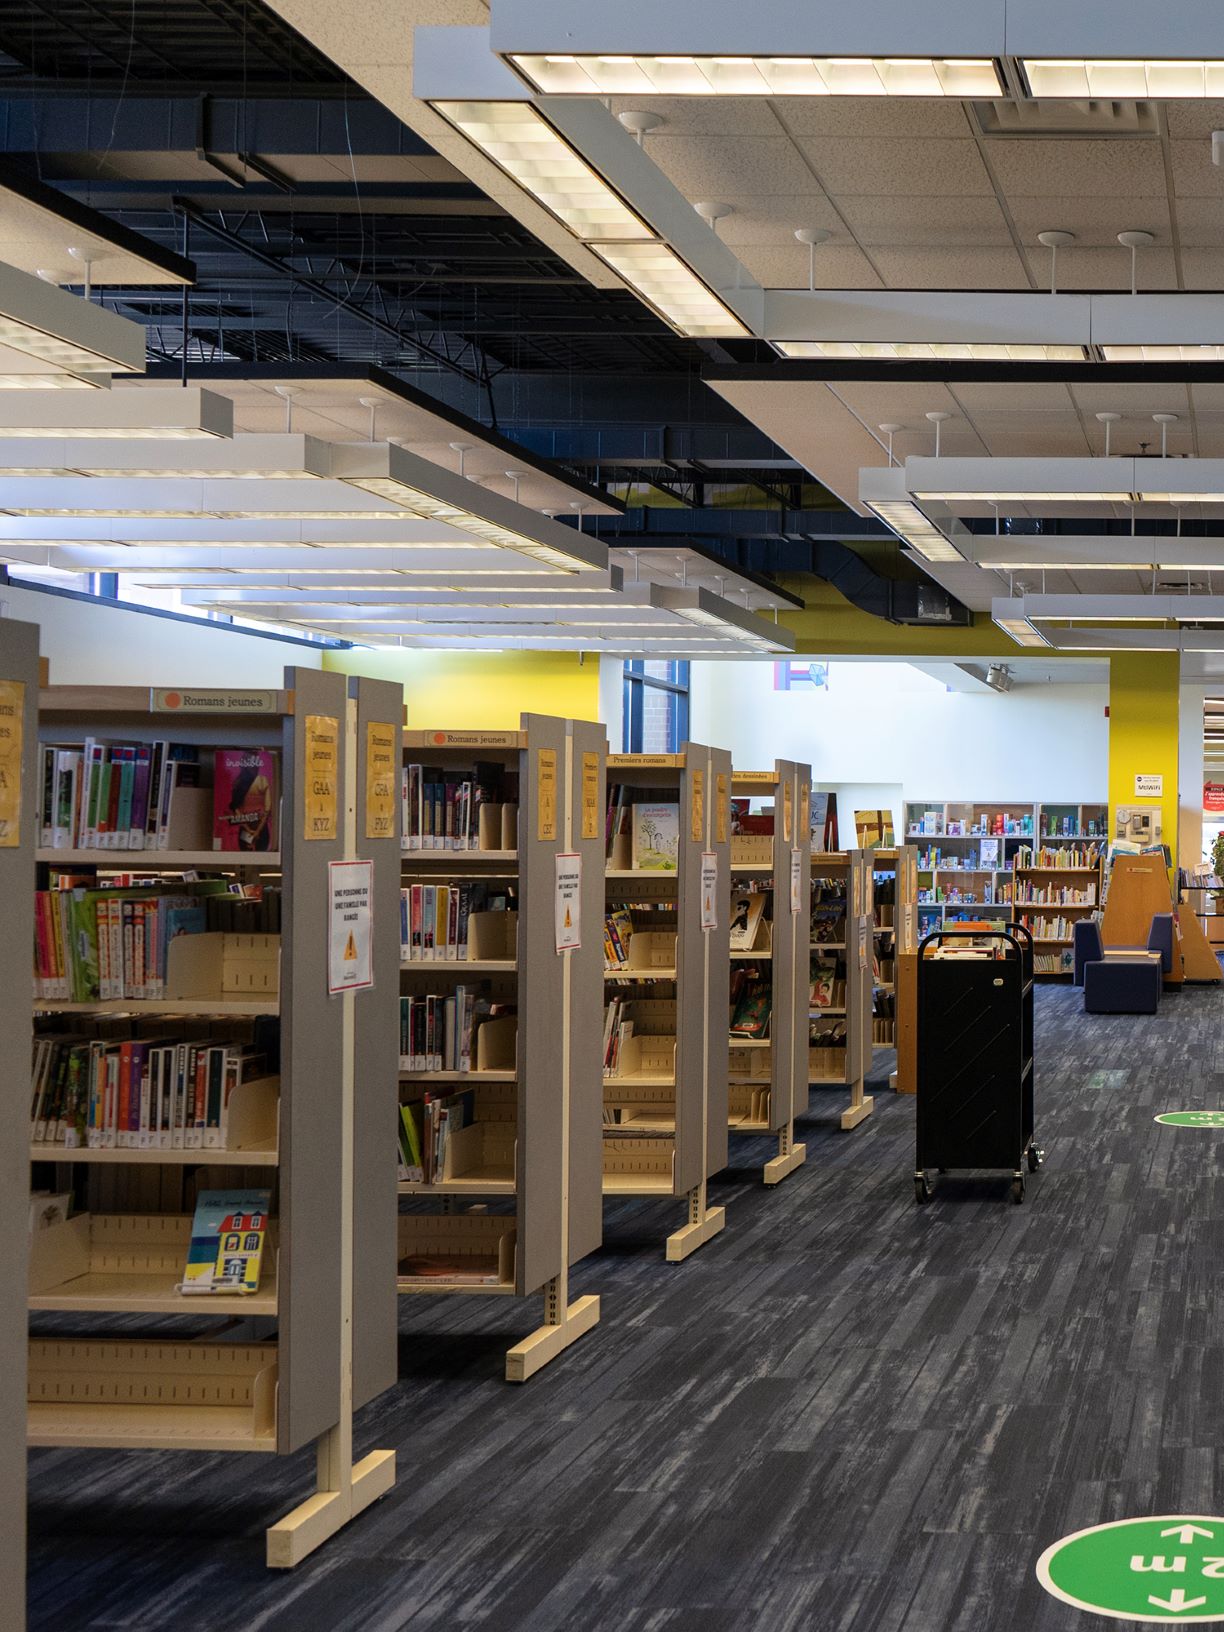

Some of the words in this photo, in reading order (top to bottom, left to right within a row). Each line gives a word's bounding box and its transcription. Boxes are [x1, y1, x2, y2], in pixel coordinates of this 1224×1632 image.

[183, 695, 225, 706] Romans
[228, 697, 263, 707] jeunes
[447, 734, 479, 743] Romans
[480, 736, 507, 744] jeunes
[225, 755, 264, 767] invisible
[613, 756, 641, 764] Premiers
[312, 781, 331, 796] GAA
[1129, 1555, 1187, 1573] m
